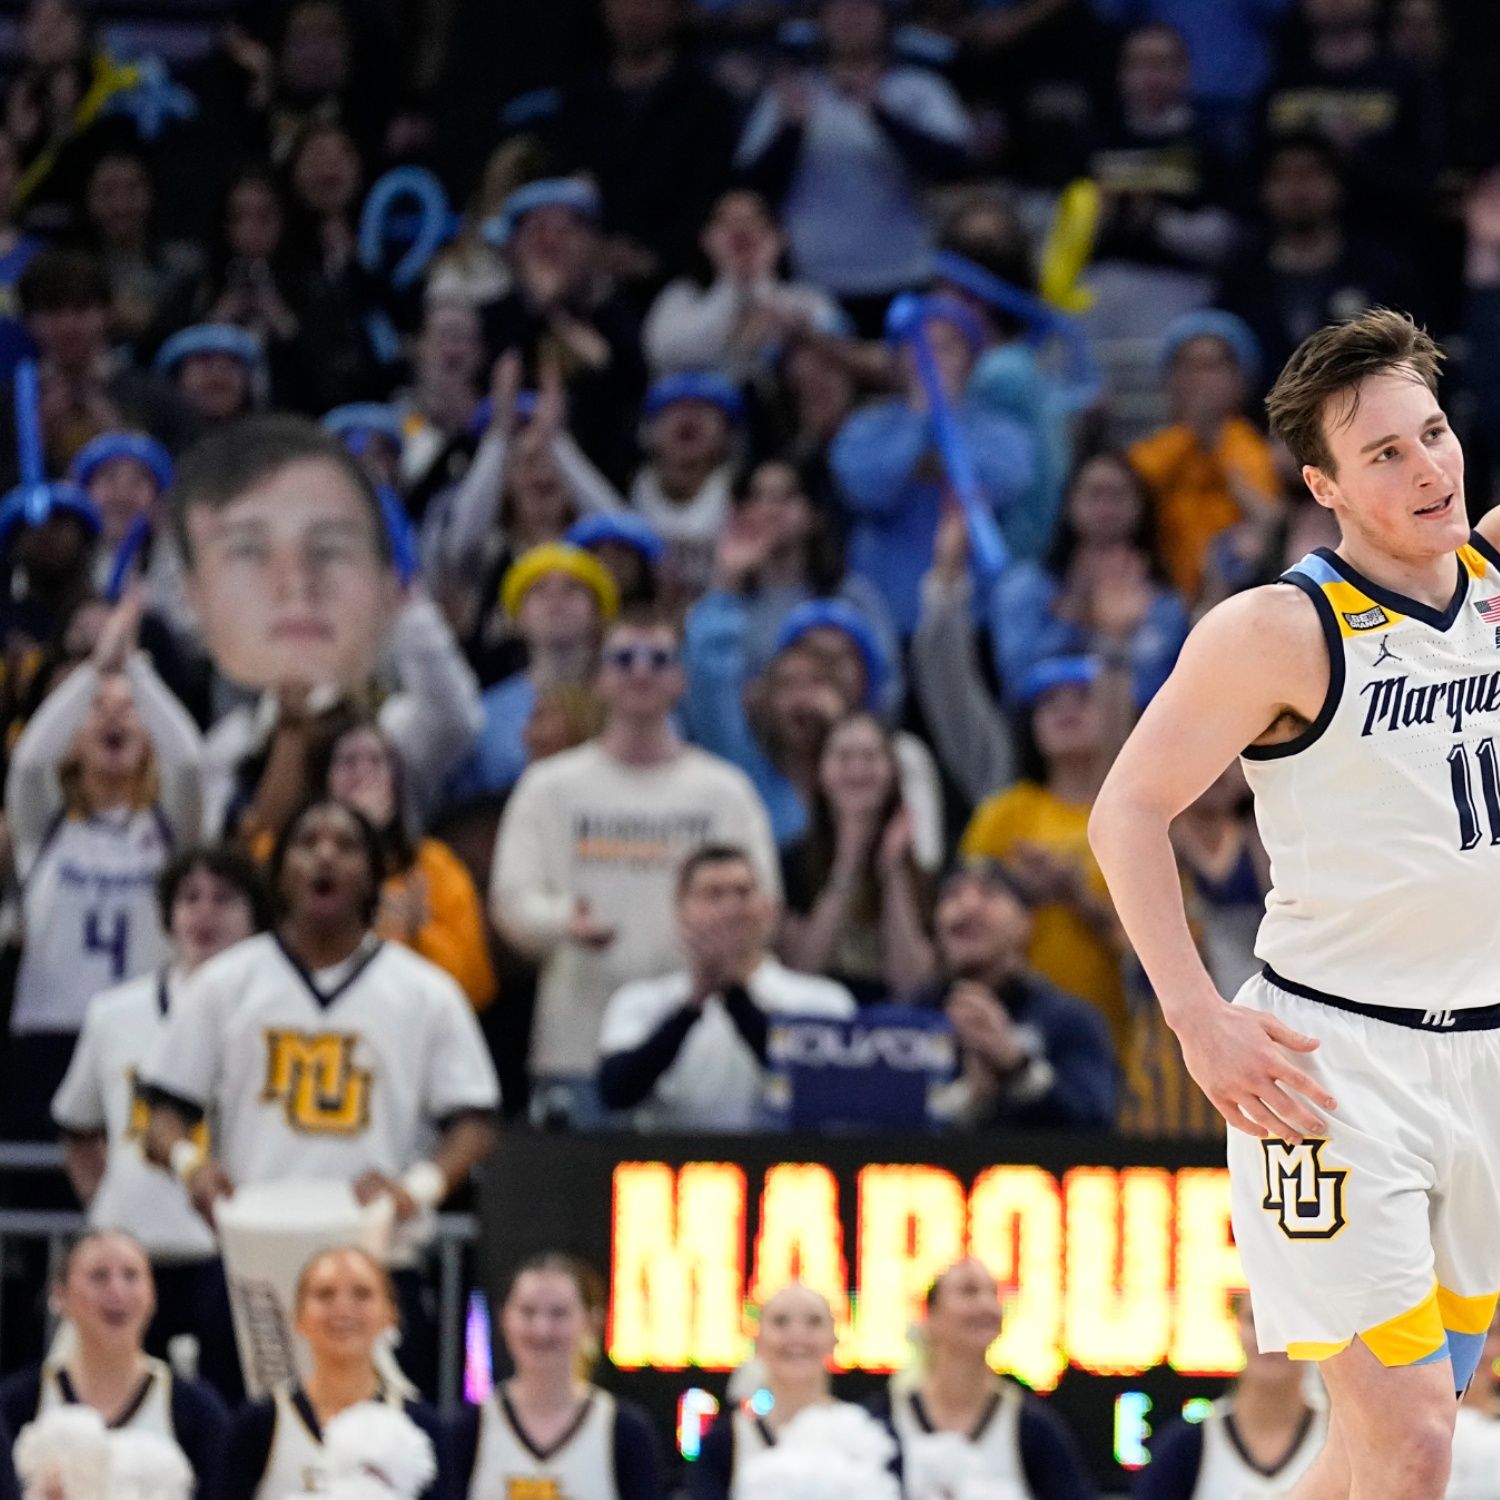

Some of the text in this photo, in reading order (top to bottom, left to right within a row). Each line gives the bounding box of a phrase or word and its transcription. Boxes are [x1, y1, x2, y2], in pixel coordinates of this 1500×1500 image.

[83, 906, 129, 982] 4
[260, 1028, 372, 1136] MU
[1260, 1136, 1351, 1242] MU
